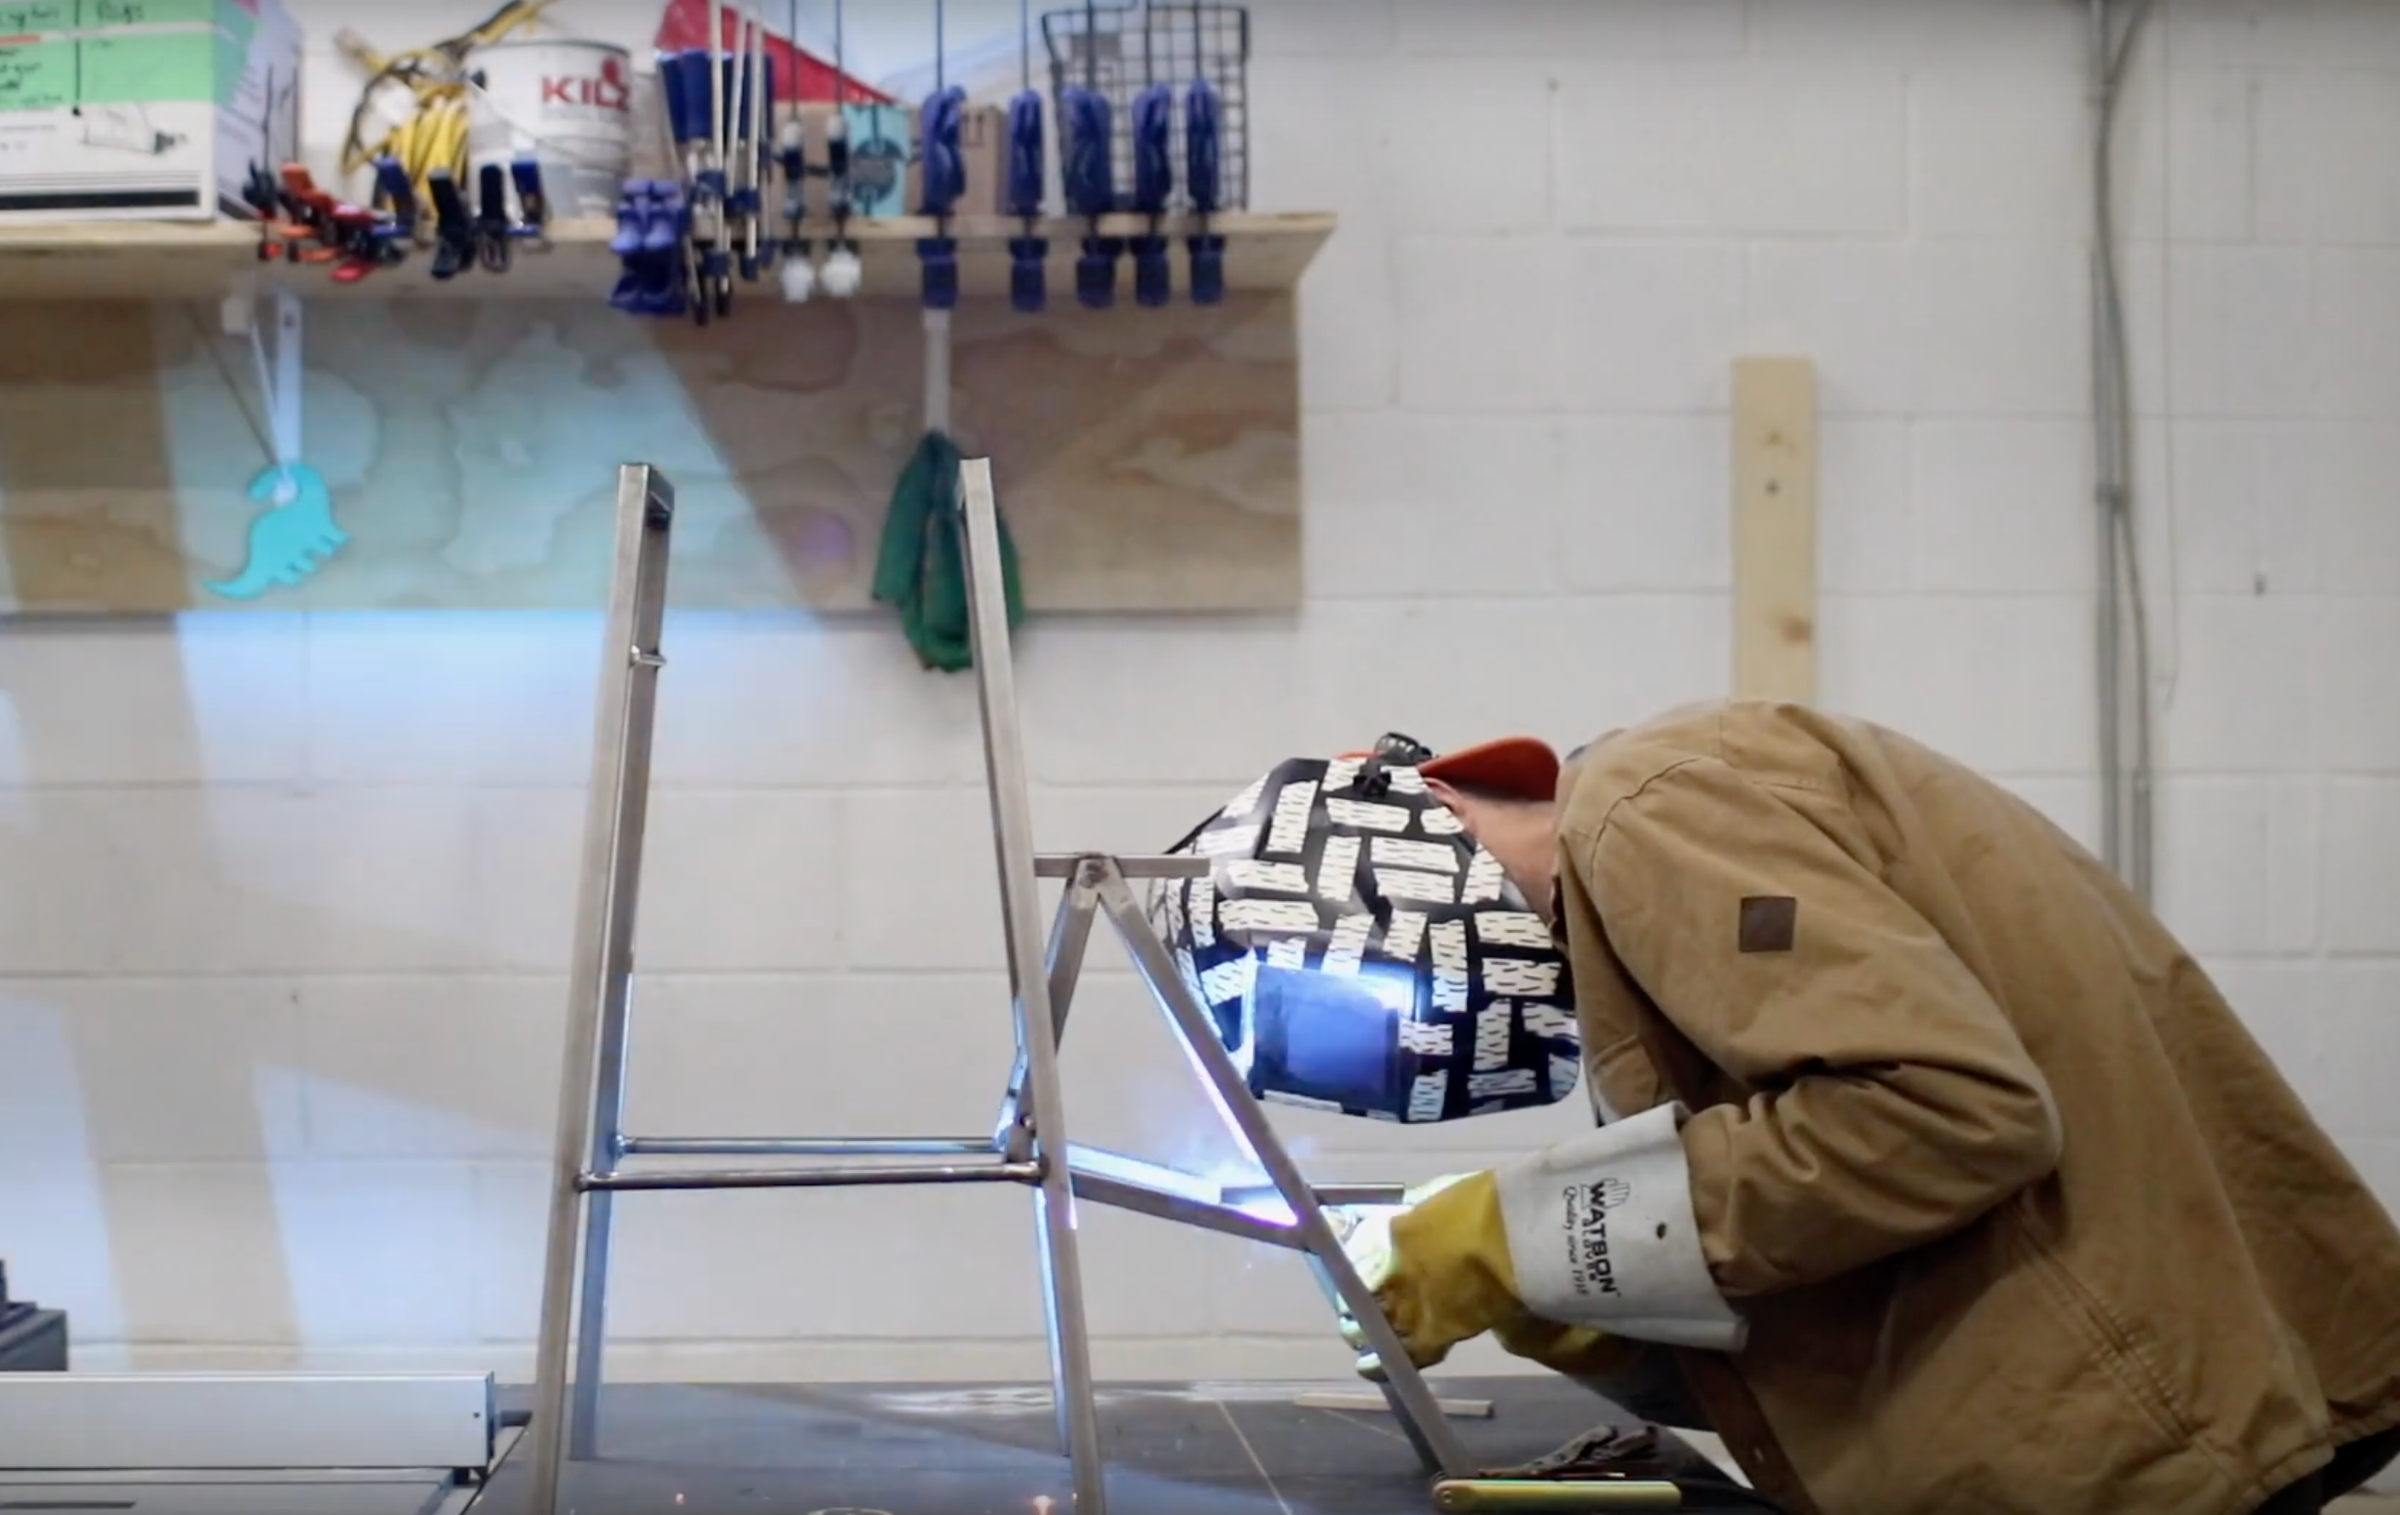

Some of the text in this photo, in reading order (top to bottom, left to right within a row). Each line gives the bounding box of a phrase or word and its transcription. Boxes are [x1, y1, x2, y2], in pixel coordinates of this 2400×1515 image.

[541, 74, 629, 113] KILZ
[1563, 1186, 1578, 1231] Quality
[1590, 1181, 1618, 1294] WATSON
